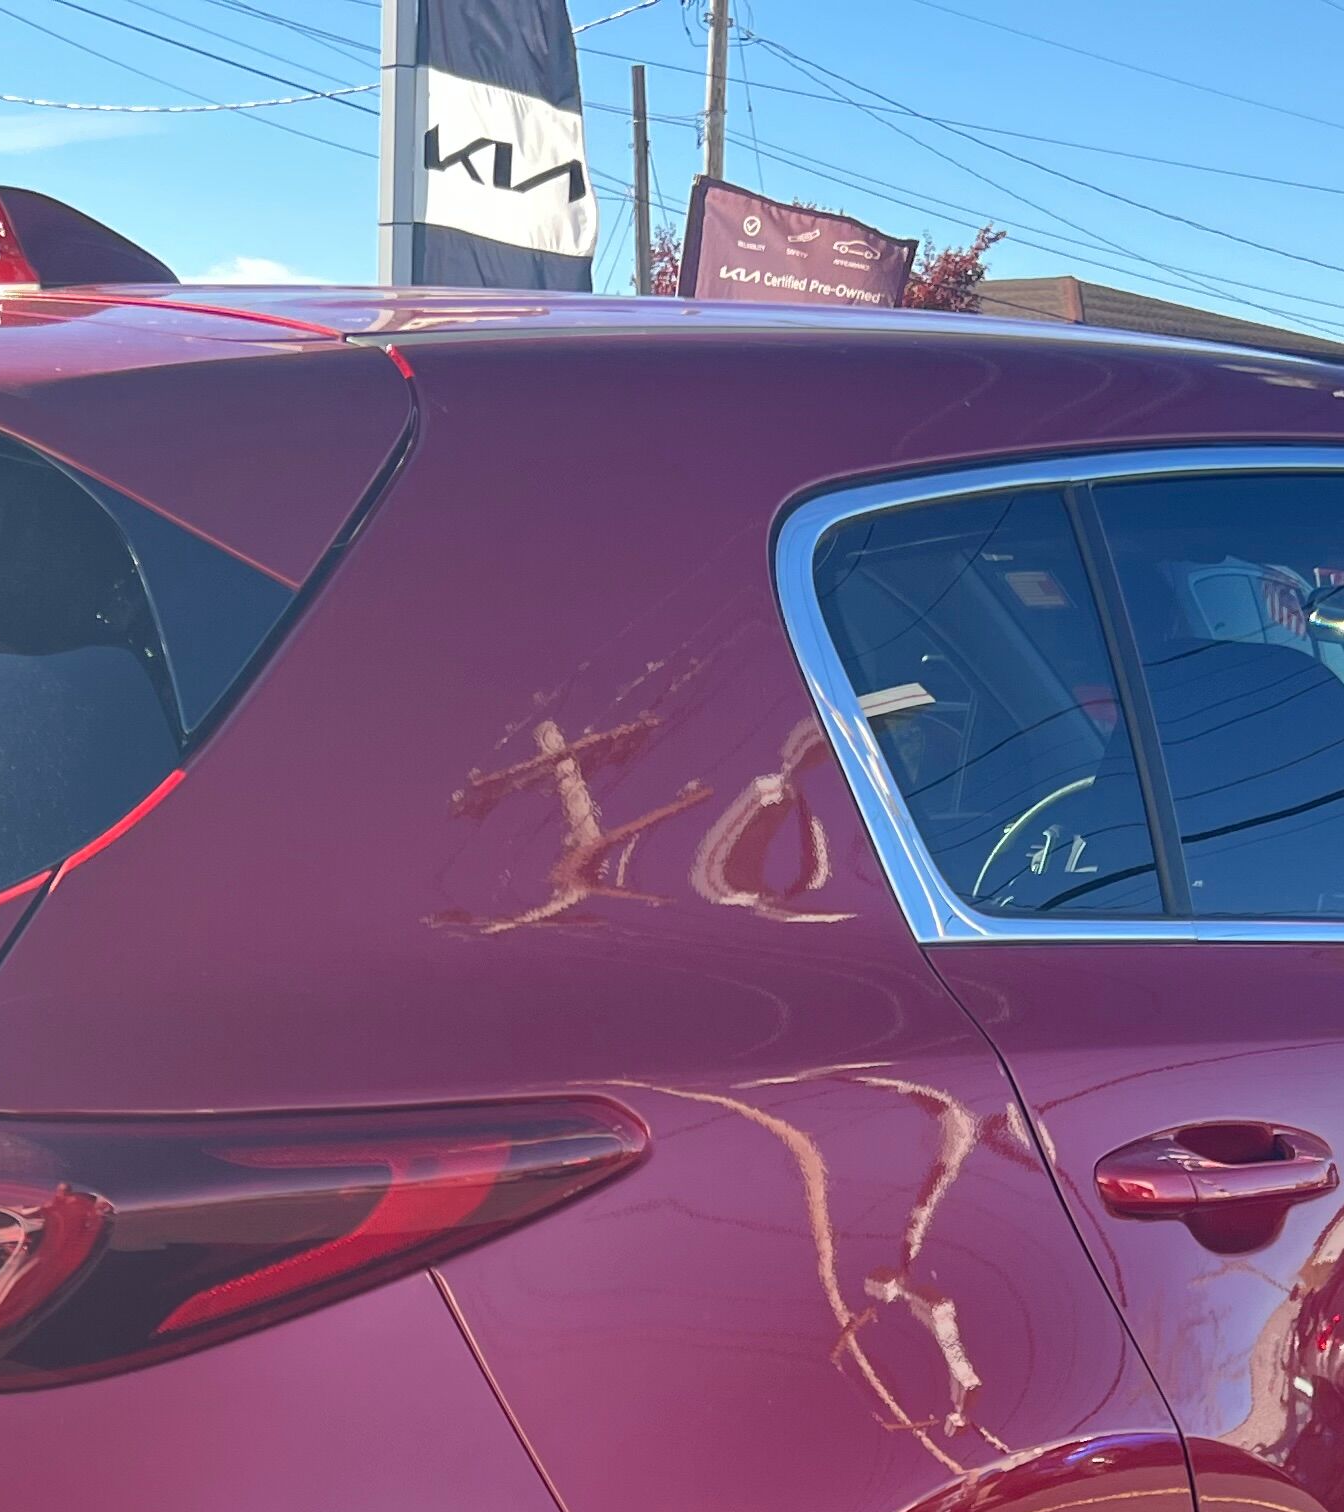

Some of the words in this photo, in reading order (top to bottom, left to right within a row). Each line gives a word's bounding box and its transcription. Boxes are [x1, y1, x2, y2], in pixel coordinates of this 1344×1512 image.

[424, 124, 587, 204] KIA
[719, 264, 761, 284] KIA
[763, 271, 807, 292] Certified
[809, 279, 881, 304] Pre-Owned
